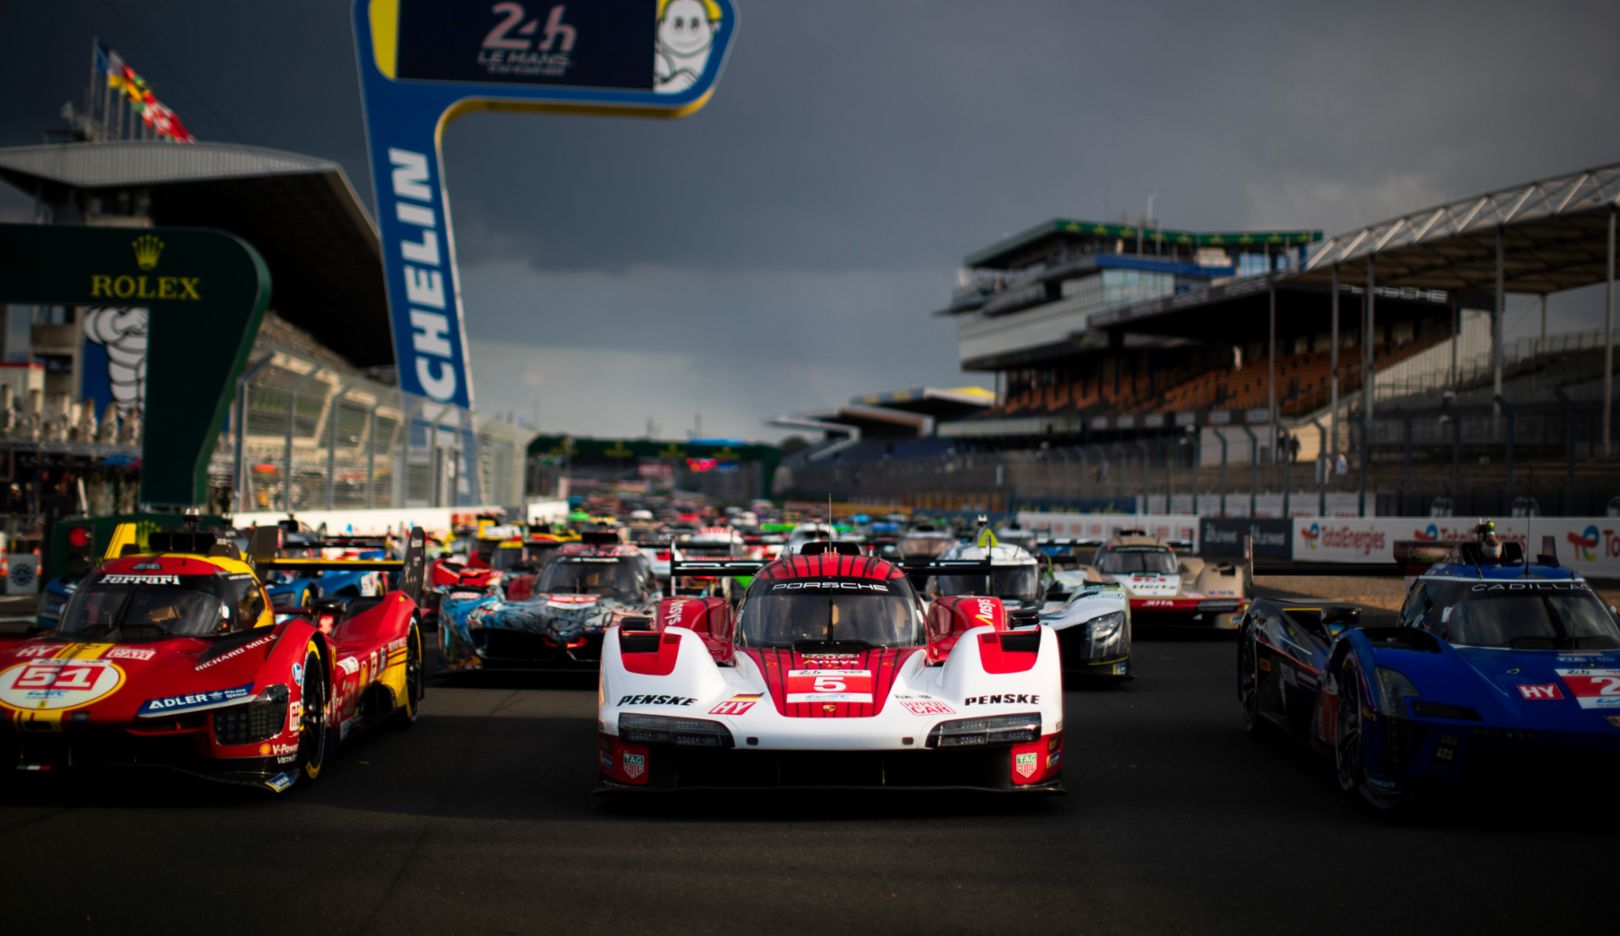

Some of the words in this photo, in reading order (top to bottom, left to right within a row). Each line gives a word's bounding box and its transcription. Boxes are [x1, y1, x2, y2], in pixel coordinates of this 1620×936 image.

[477, 50, 504, 65] LE
[90, 273, 202, 300] ROLEX
[98, 574, 182, 586] Ferrari
[772, 581, 889, 592] PORSCHE
[194, 647, 246, 672] RICHARD
[245, 634, 277, 650] MILLE
[17, 669, 92, 687] 51
[813, 676, 847, 693] 5
[1519, 684, 1556, 698] HY
[148, 693, 209, 710] ADLER
[617, 694, 698, 706] PENSKE
[965, 694, 1040, 706] PENSKE
[711, 701, 754, 715] HY
[624, 754, 644, 765] TAG
[1017, 754, 1036, 764] TAG
